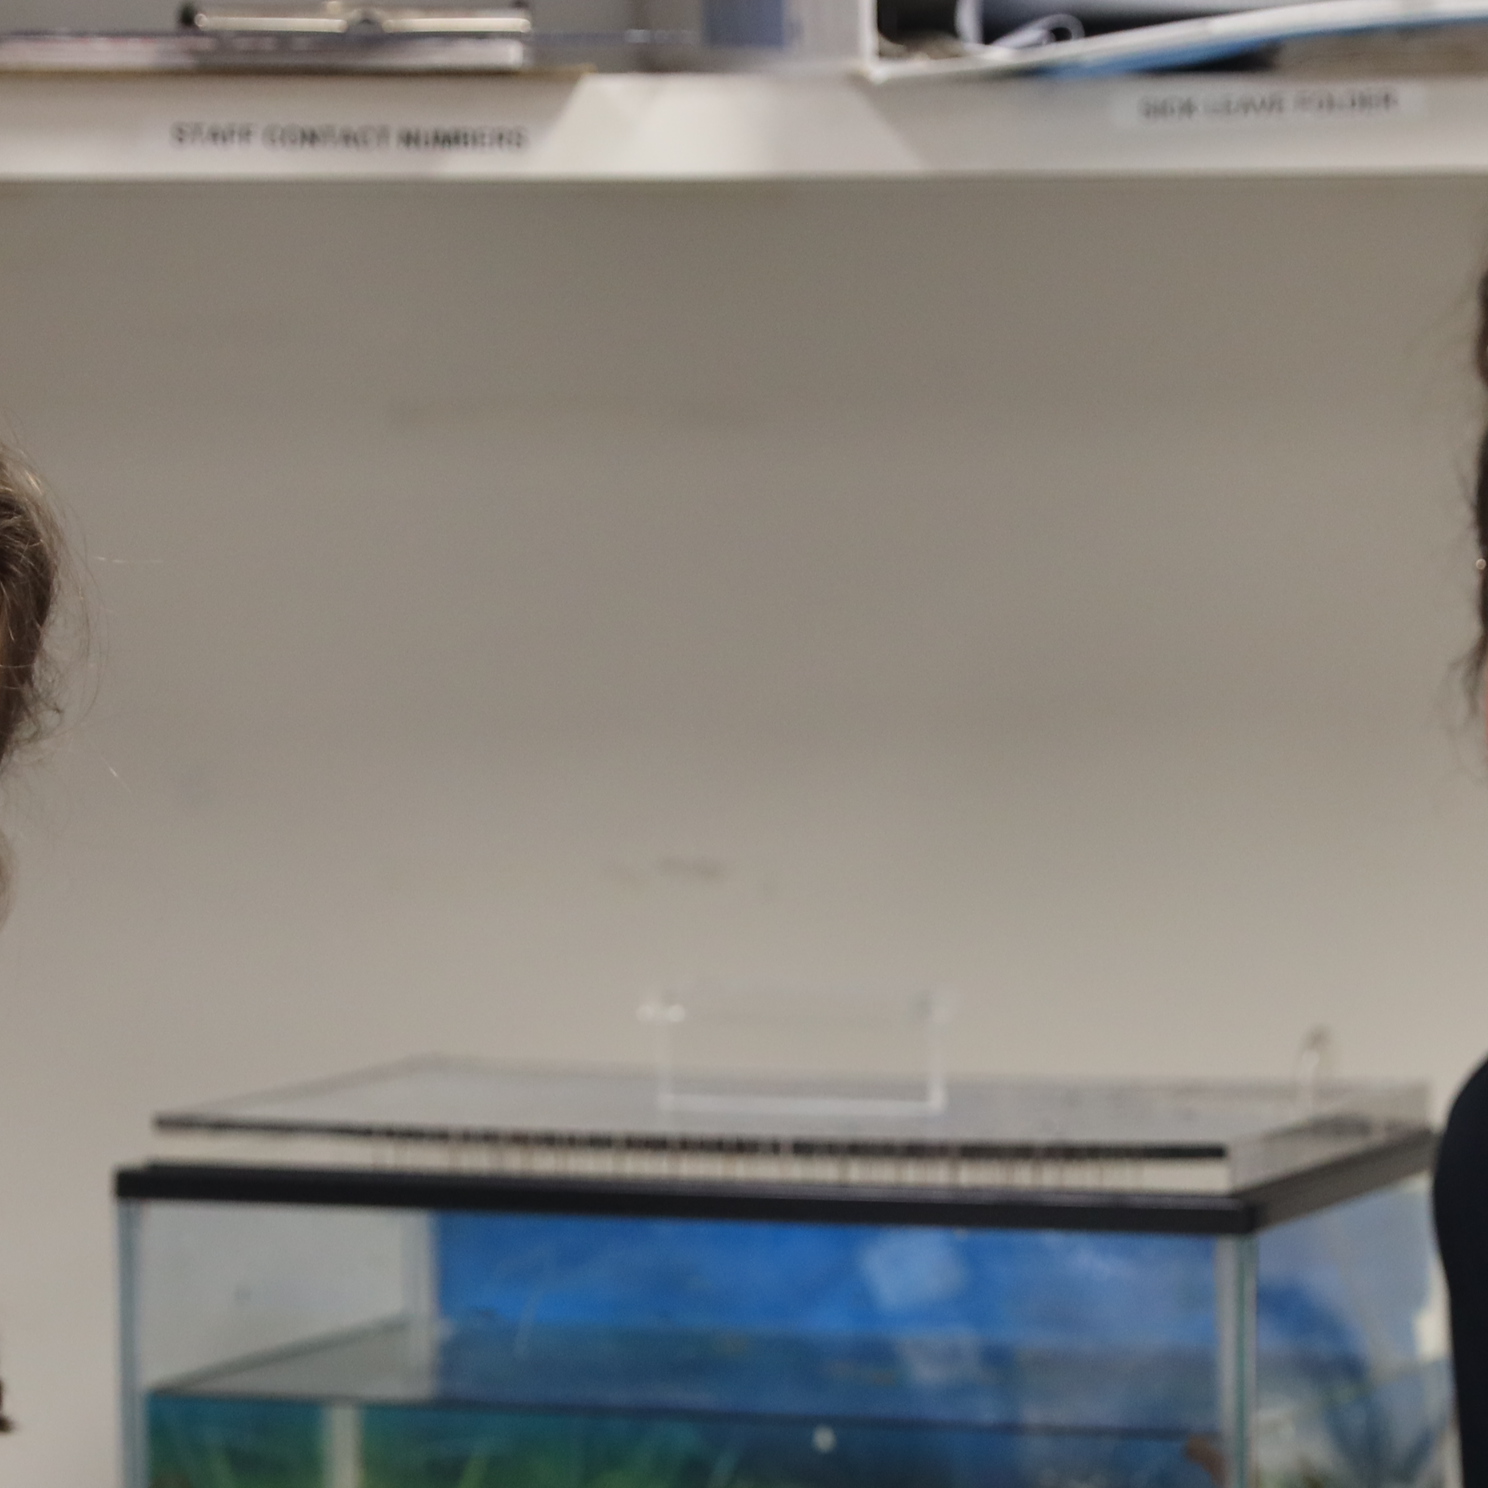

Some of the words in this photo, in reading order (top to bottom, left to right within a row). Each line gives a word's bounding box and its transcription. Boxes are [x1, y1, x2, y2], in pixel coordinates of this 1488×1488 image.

[170, 121, 254, 149] STAFF
[262, 122, 391, 150] CONTACT
[396, 123, 530, 151] NUMBERS
